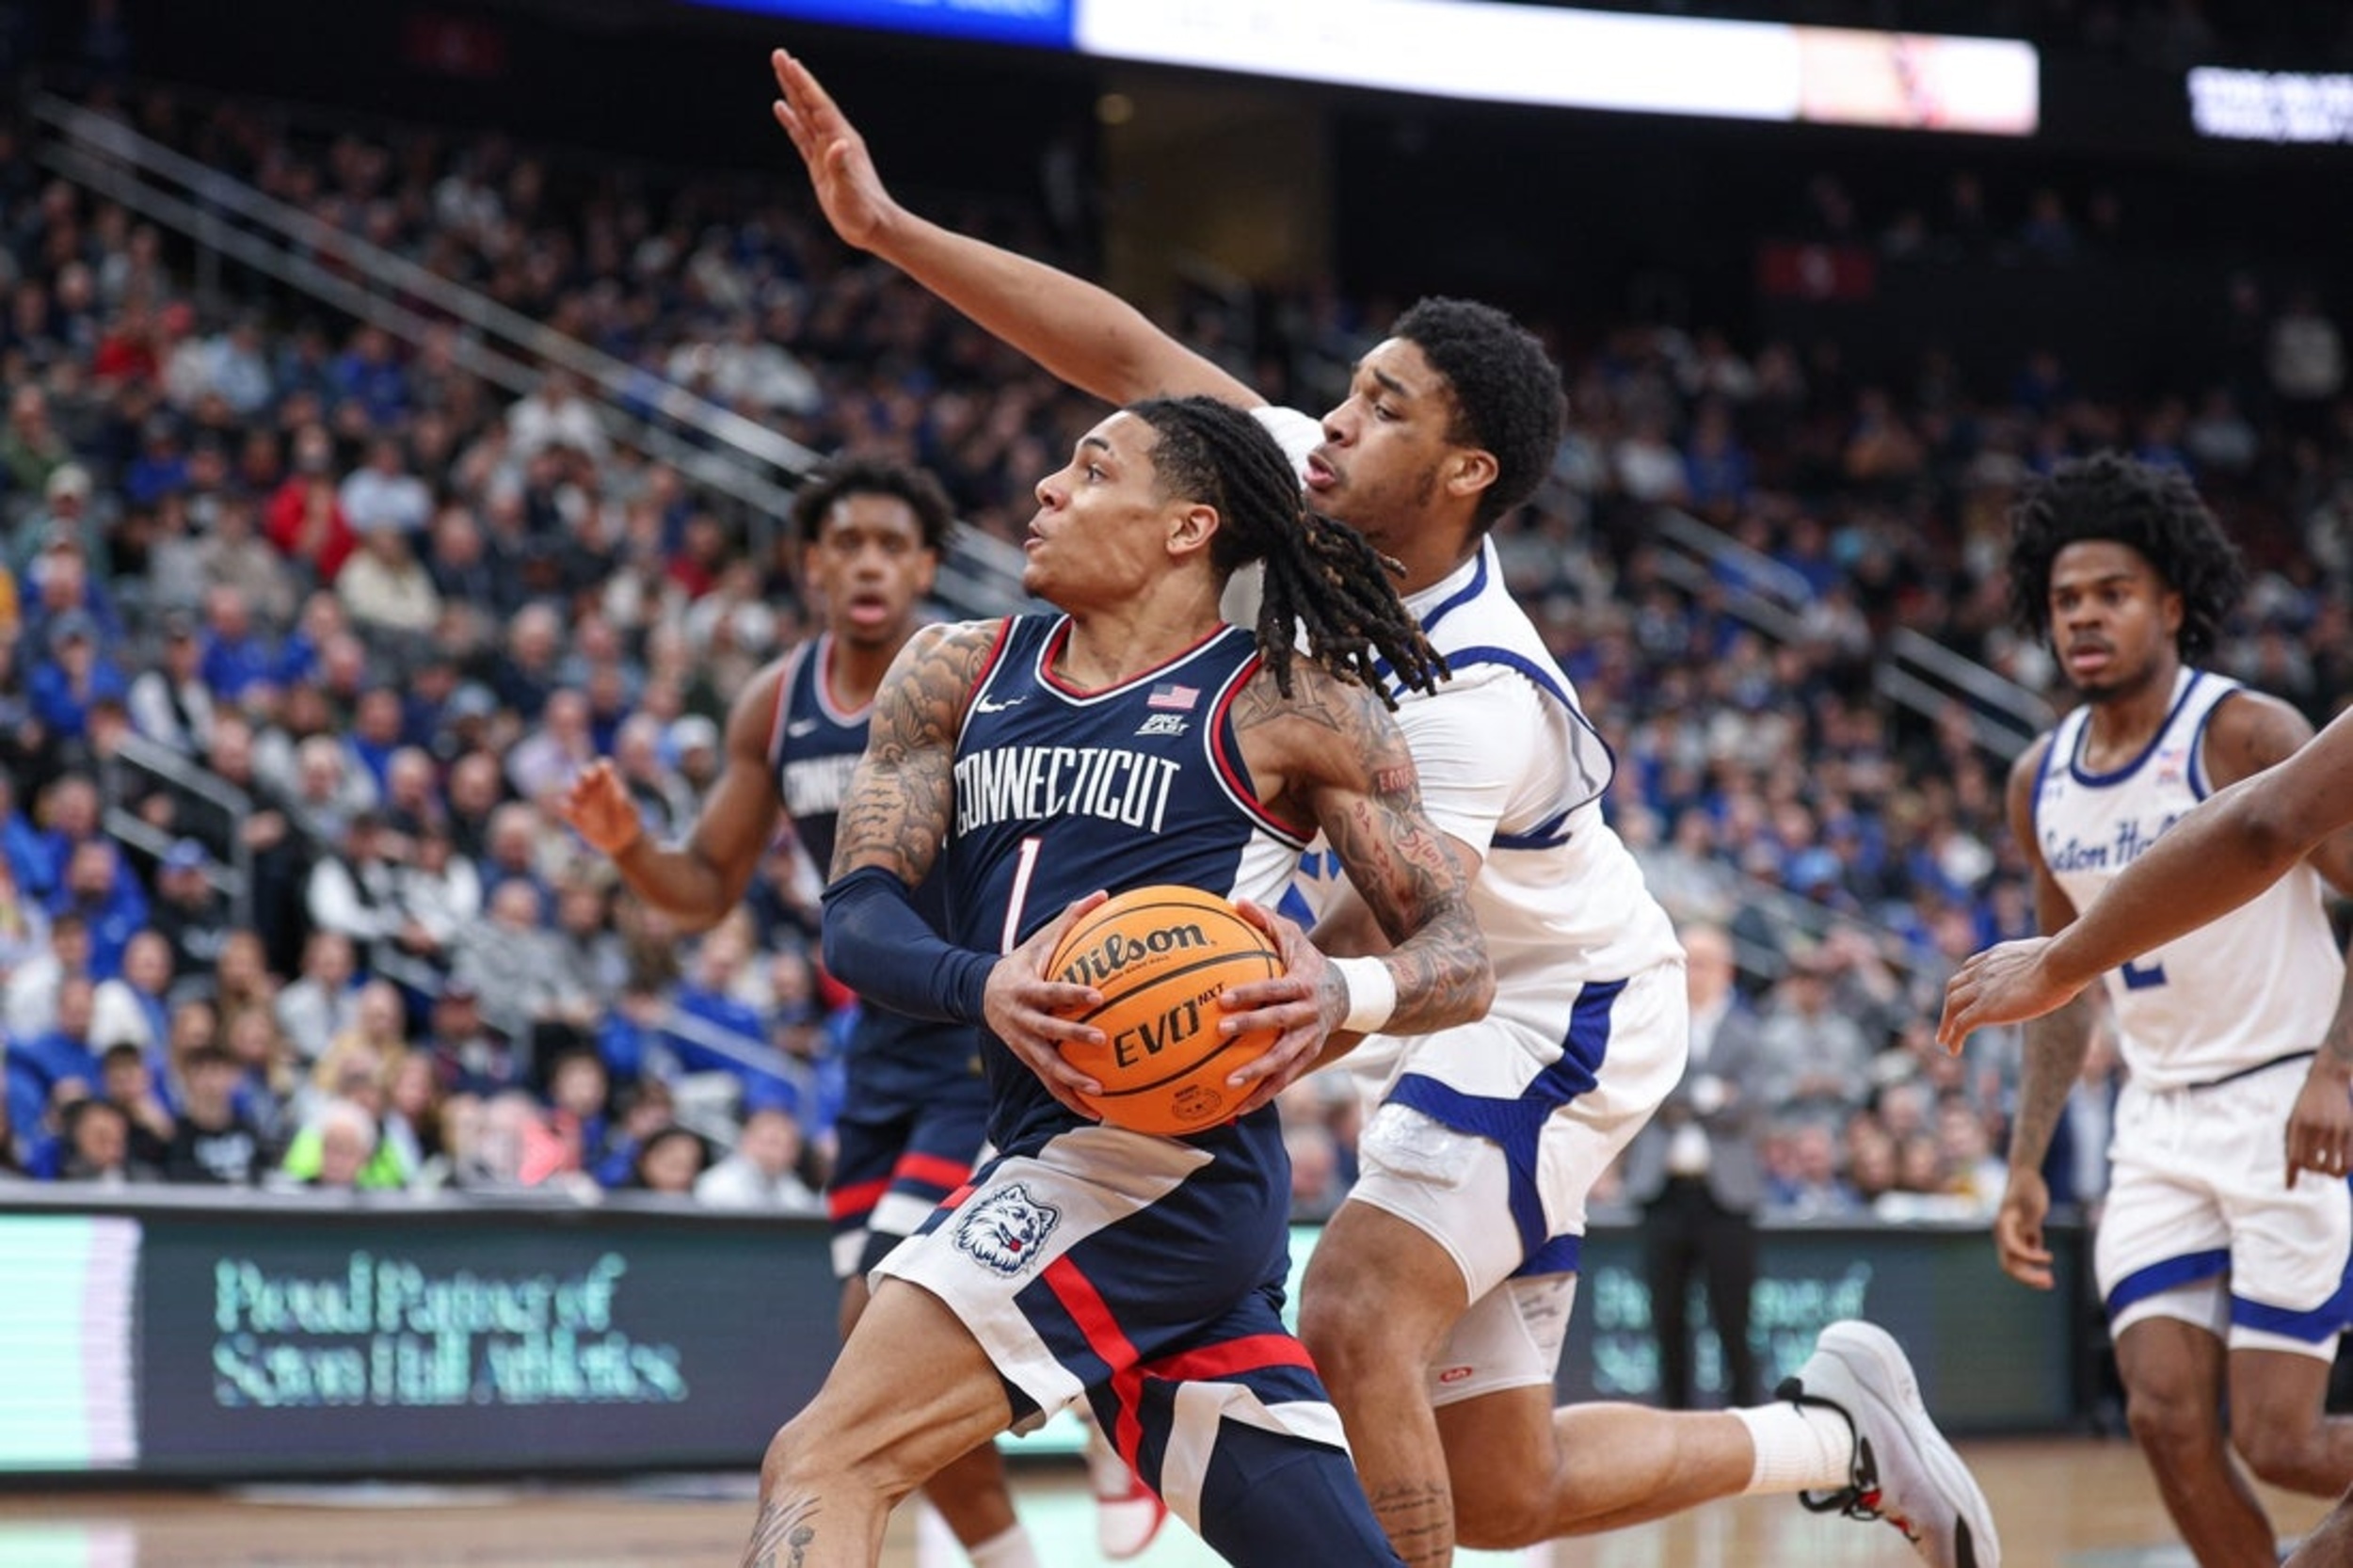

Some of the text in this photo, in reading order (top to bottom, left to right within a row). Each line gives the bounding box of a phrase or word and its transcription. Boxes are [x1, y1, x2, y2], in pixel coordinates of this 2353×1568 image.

[953, 748, 1181, 835] CONNECTICUT
[1001, 838, 1044, 957] 1
[1114, 983, 1224, 1068] EVO NXT
